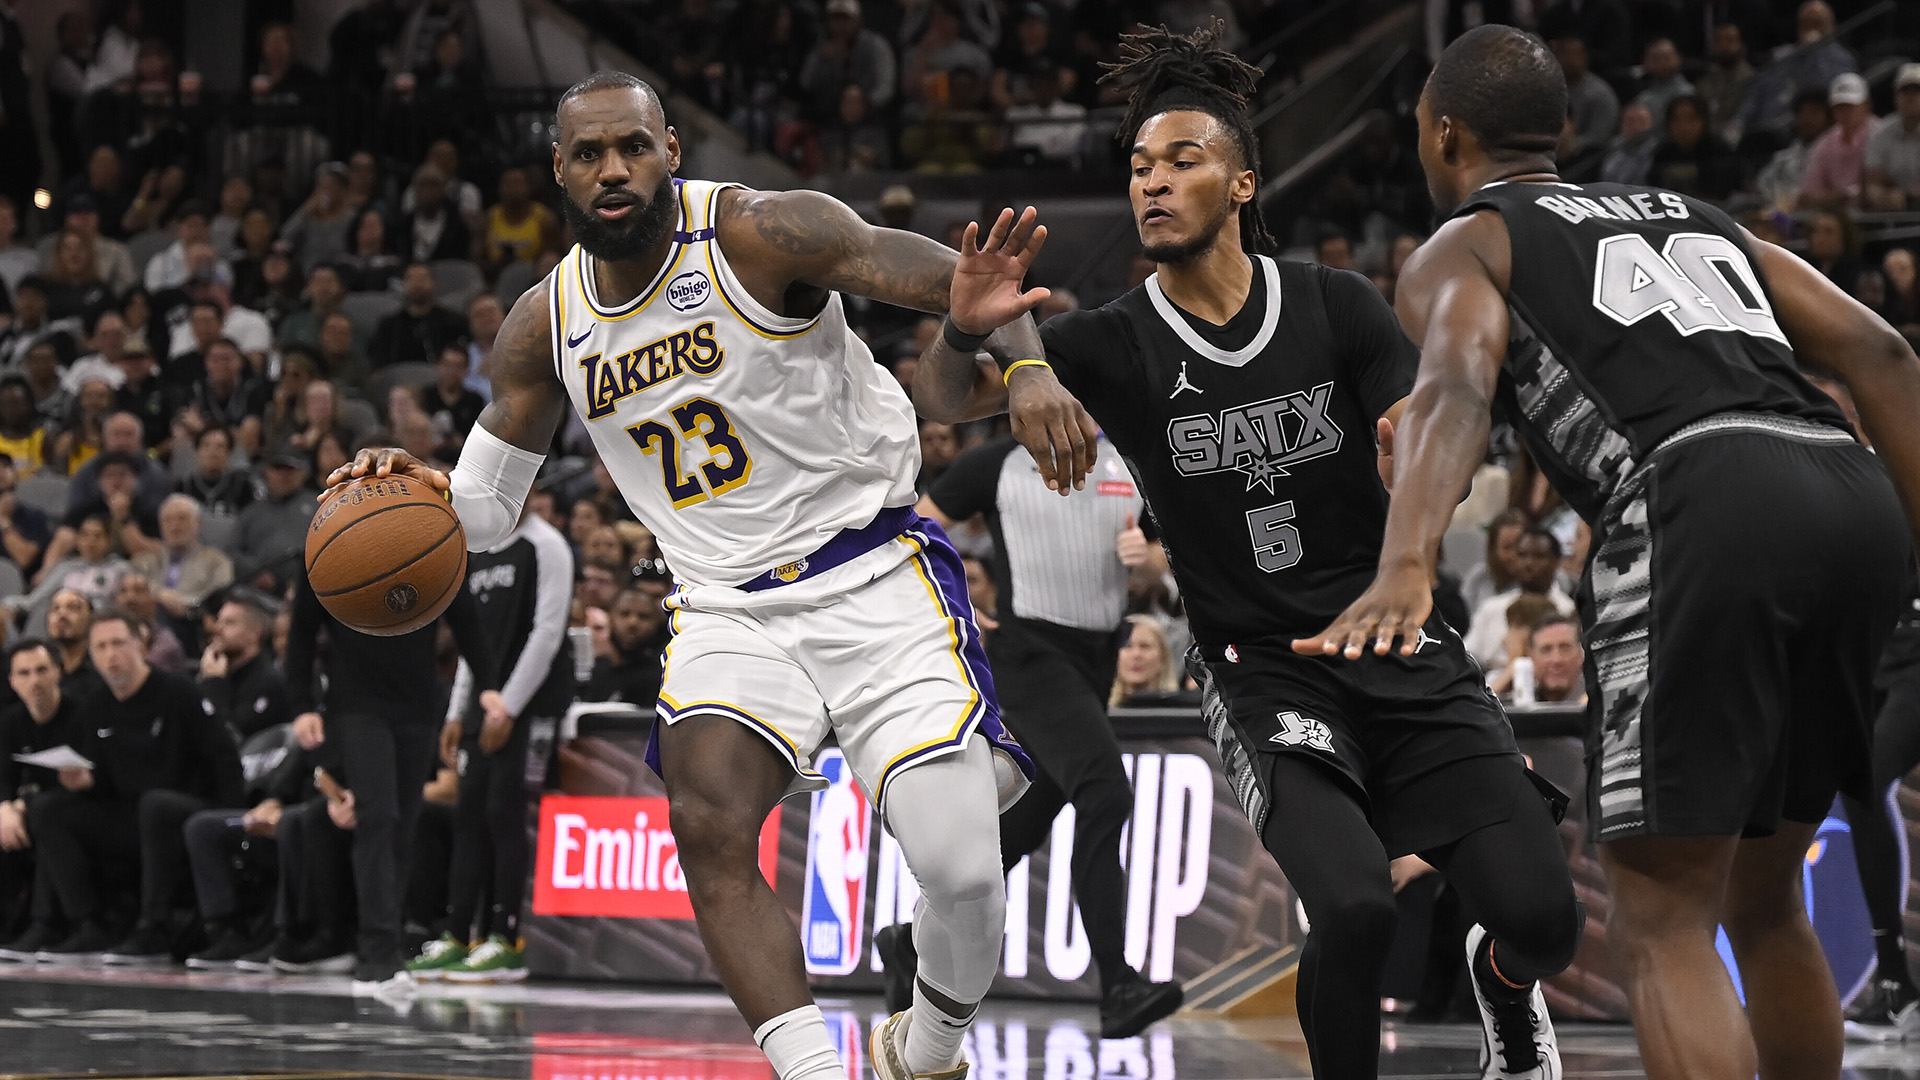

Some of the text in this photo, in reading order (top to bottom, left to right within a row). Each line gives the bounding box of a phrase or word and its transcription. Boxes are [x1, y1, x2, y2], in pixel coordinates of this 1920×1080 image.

[1535, 192, 1690, 224] BARNES
[670, 281, 708, 299] bibigo
[1592, 233, 1793, 351] 40
[579, 321, 725, 422] LAKERS
[624, 397, 753, 510] 23
[1167, 381, 1344, 478] SATX
[770, 557, 809, 580] LAKERS
[1246, 500, 1303, 573] 5
[552, 811, 688, 891] Emira
[810, 921, 840, 959] NBA
